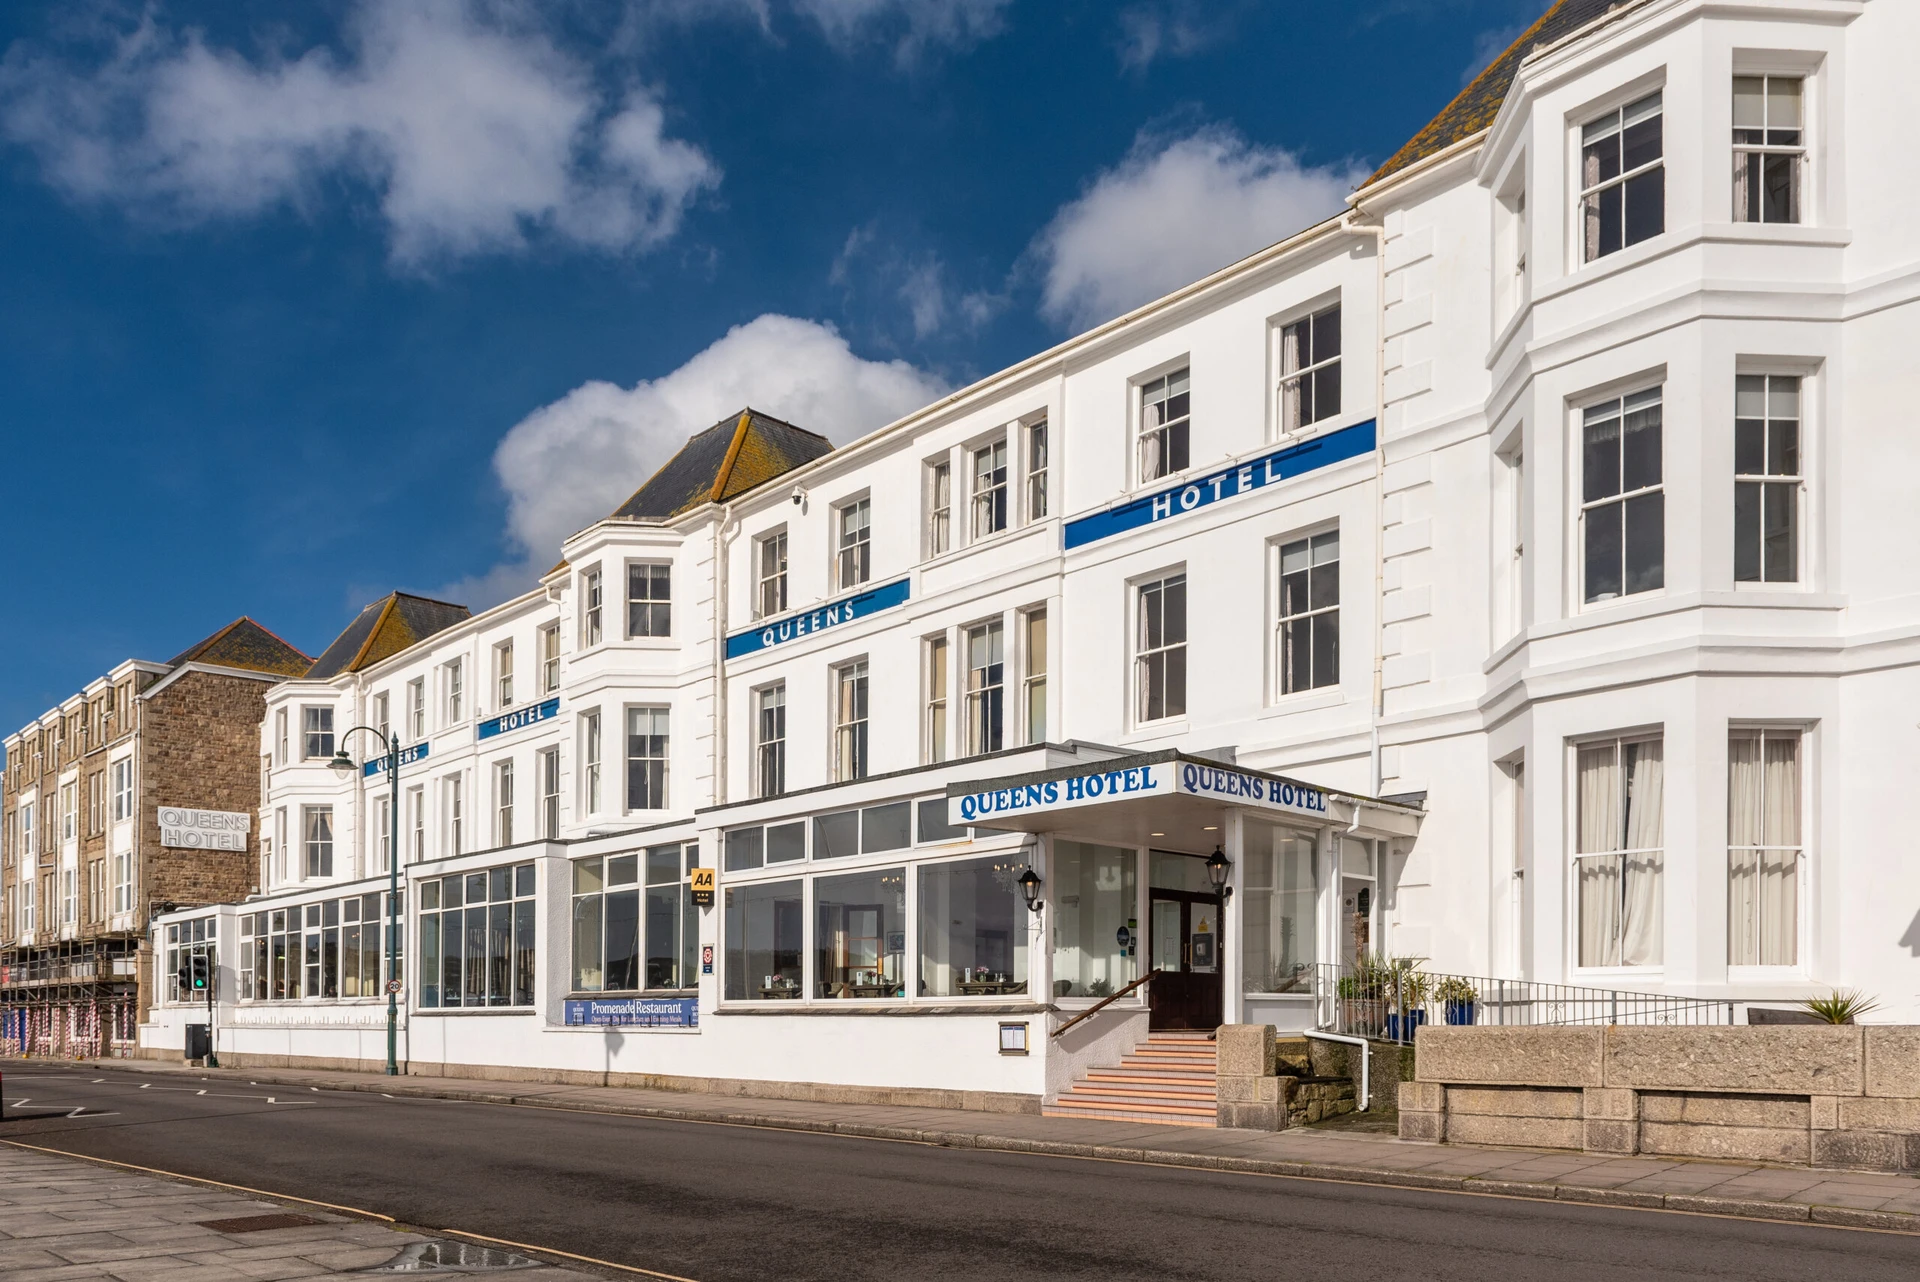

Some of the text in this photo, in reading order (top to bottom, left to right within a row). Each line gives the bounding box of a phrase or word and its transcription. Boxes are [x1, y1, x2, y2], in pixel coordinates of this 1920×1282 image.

[1152, 459, 1281, 521] HOTEL
[762, 601, 854, 647] QUEENS
[499, 705, 544, 732] HOTEL
[377, 748, 418, 772] QUENS
[961, 766, 1157, 820] QUEENS HOTEL
[1183, 764, 1326, 812] QUEENS HOTEL
[161, 809, 249, 832] QUEENS
[165, 829, 245, 850] HOTEL
[694, 873, 712, 886] AA
[591, 1001, 635, 1014] Promenade
[636, 1001, 682, 1014] Restaurant
